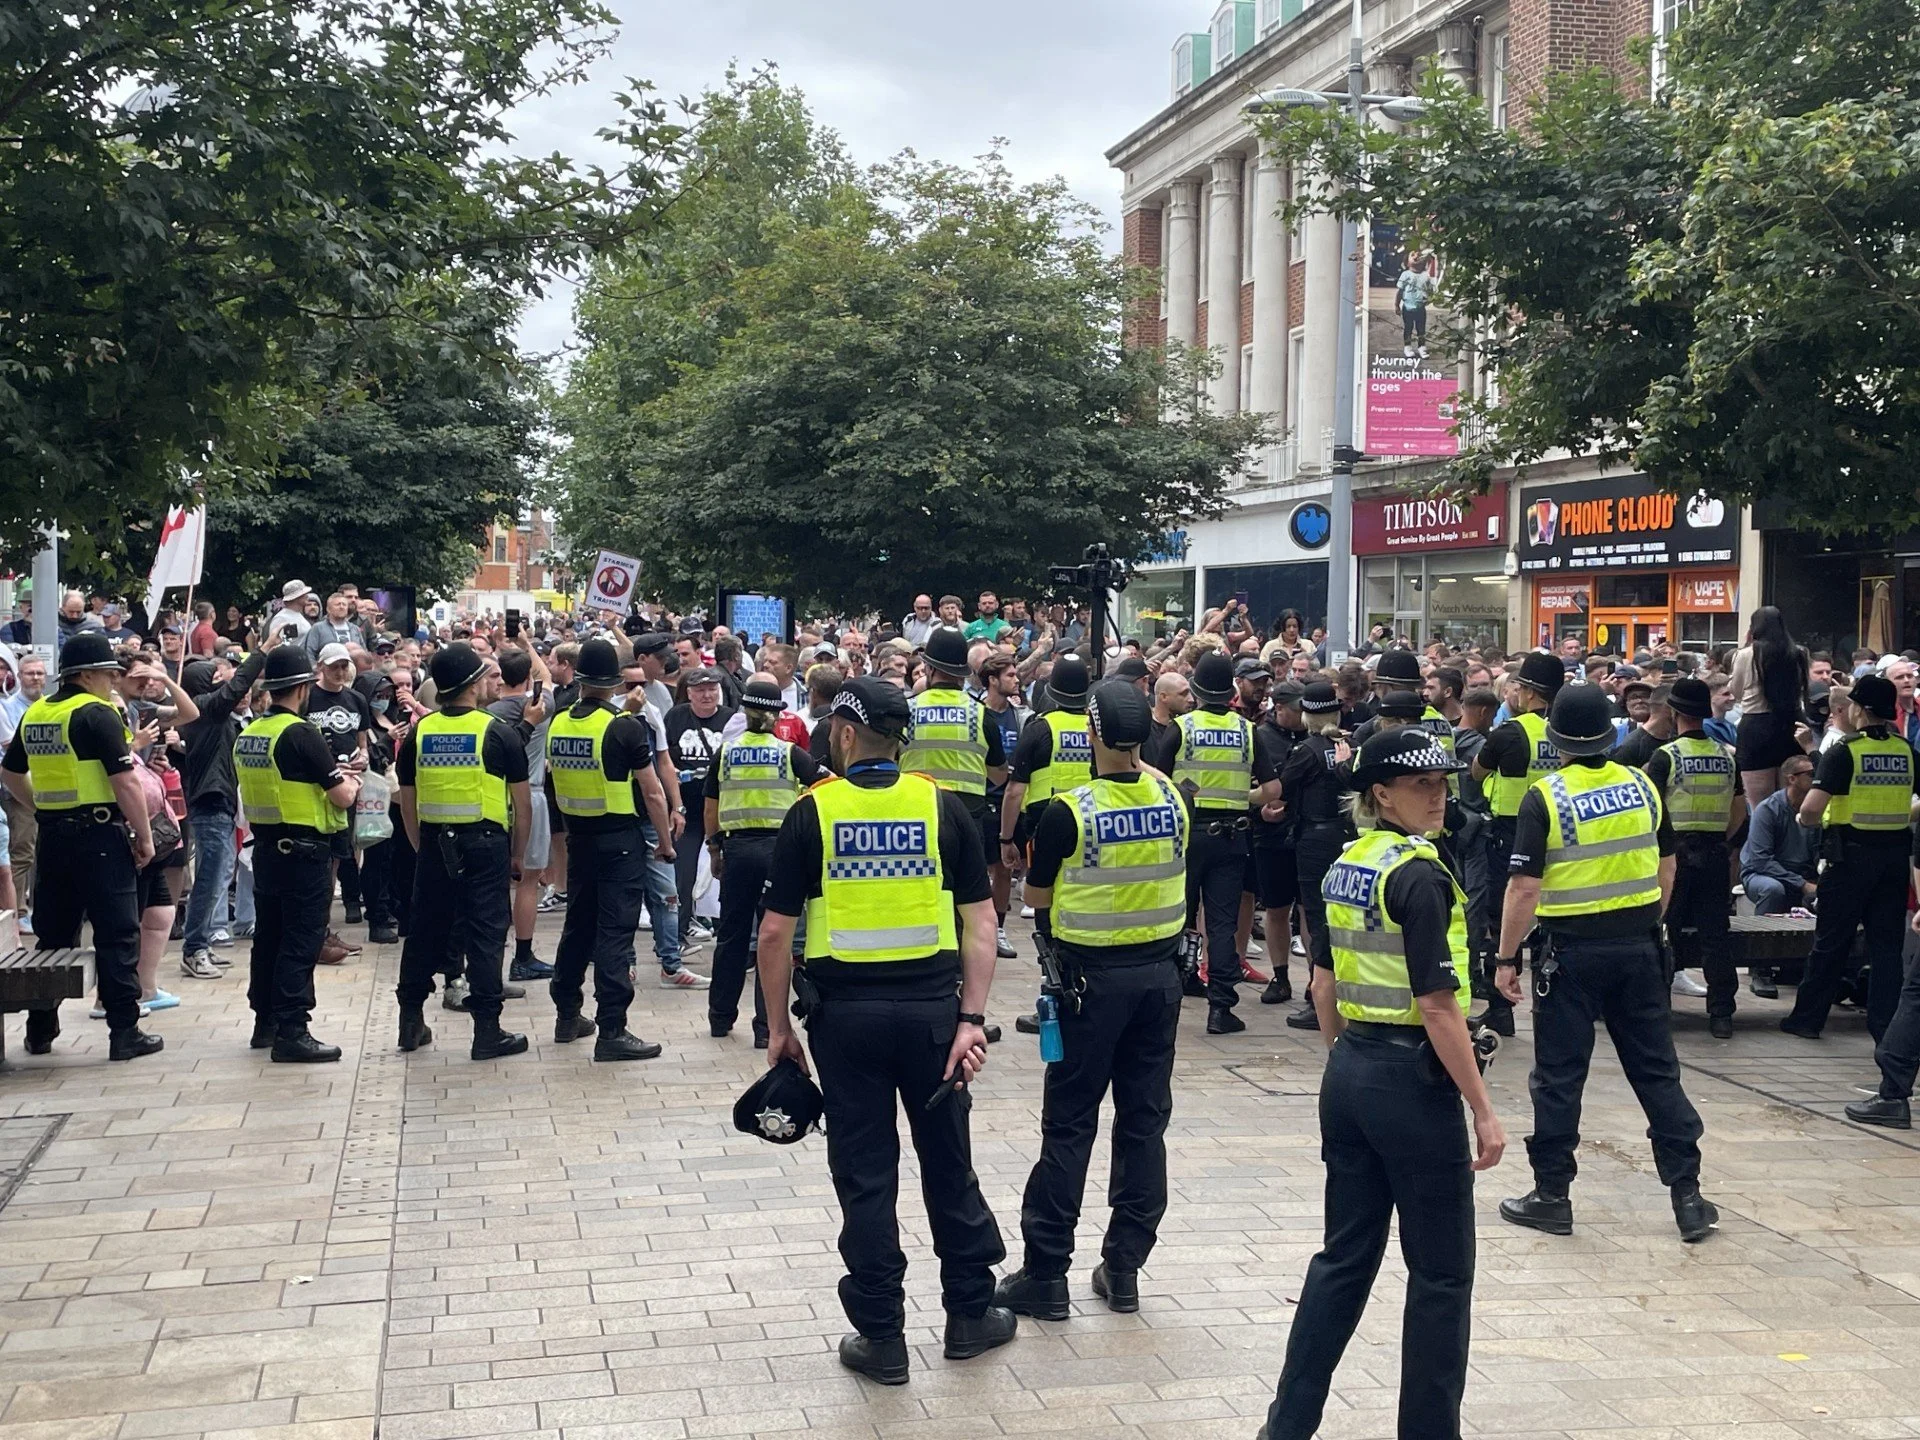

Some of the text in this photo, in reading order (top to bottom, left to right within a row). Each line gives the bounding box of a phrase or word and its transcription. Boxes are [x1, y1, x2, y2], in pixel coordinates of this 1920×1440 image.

[1372, 354, 1420, 368] Journey
[1371, 368, 1442, 382] through the
[1371, 383, 1400, 394] ages
[1384, 498, 1463, 530] TIMPSON
[1560, 494, 1674, 536] PHONE CLOUD
[603, 557, 634, 569] STARMER
[1695, 581, 1725, 596] VAPE
[593, 595, 622, 606] TRAITOR
[1541, 596, 1571, 608] REPAIR
[1432, 604, 1507, 616] Watch Workshop
[917, 707, 966, 724] POLICE
[237, 737, 269, 753] POLICE
[431, 736, 468, 744] POLICE
[1061, 733, 1090, 747] POLI
[1195, 732, 1241, 747] POLICE
[432, 744, 464, 752] MEDIC
[551, 739, 592, 757] POLICE
[731, 749, 779, 764] POLICE
[1864, 755, 1907, 771] POLICE
[1685, 759, 1728, 772] POLICE
[1577, 786, 1643, 818] POLICE
[1100, 810, 1174, 840] POLICE
[838, 826, 923, 852] POLICE
[1325, 868, 1373, 902] POLICE
